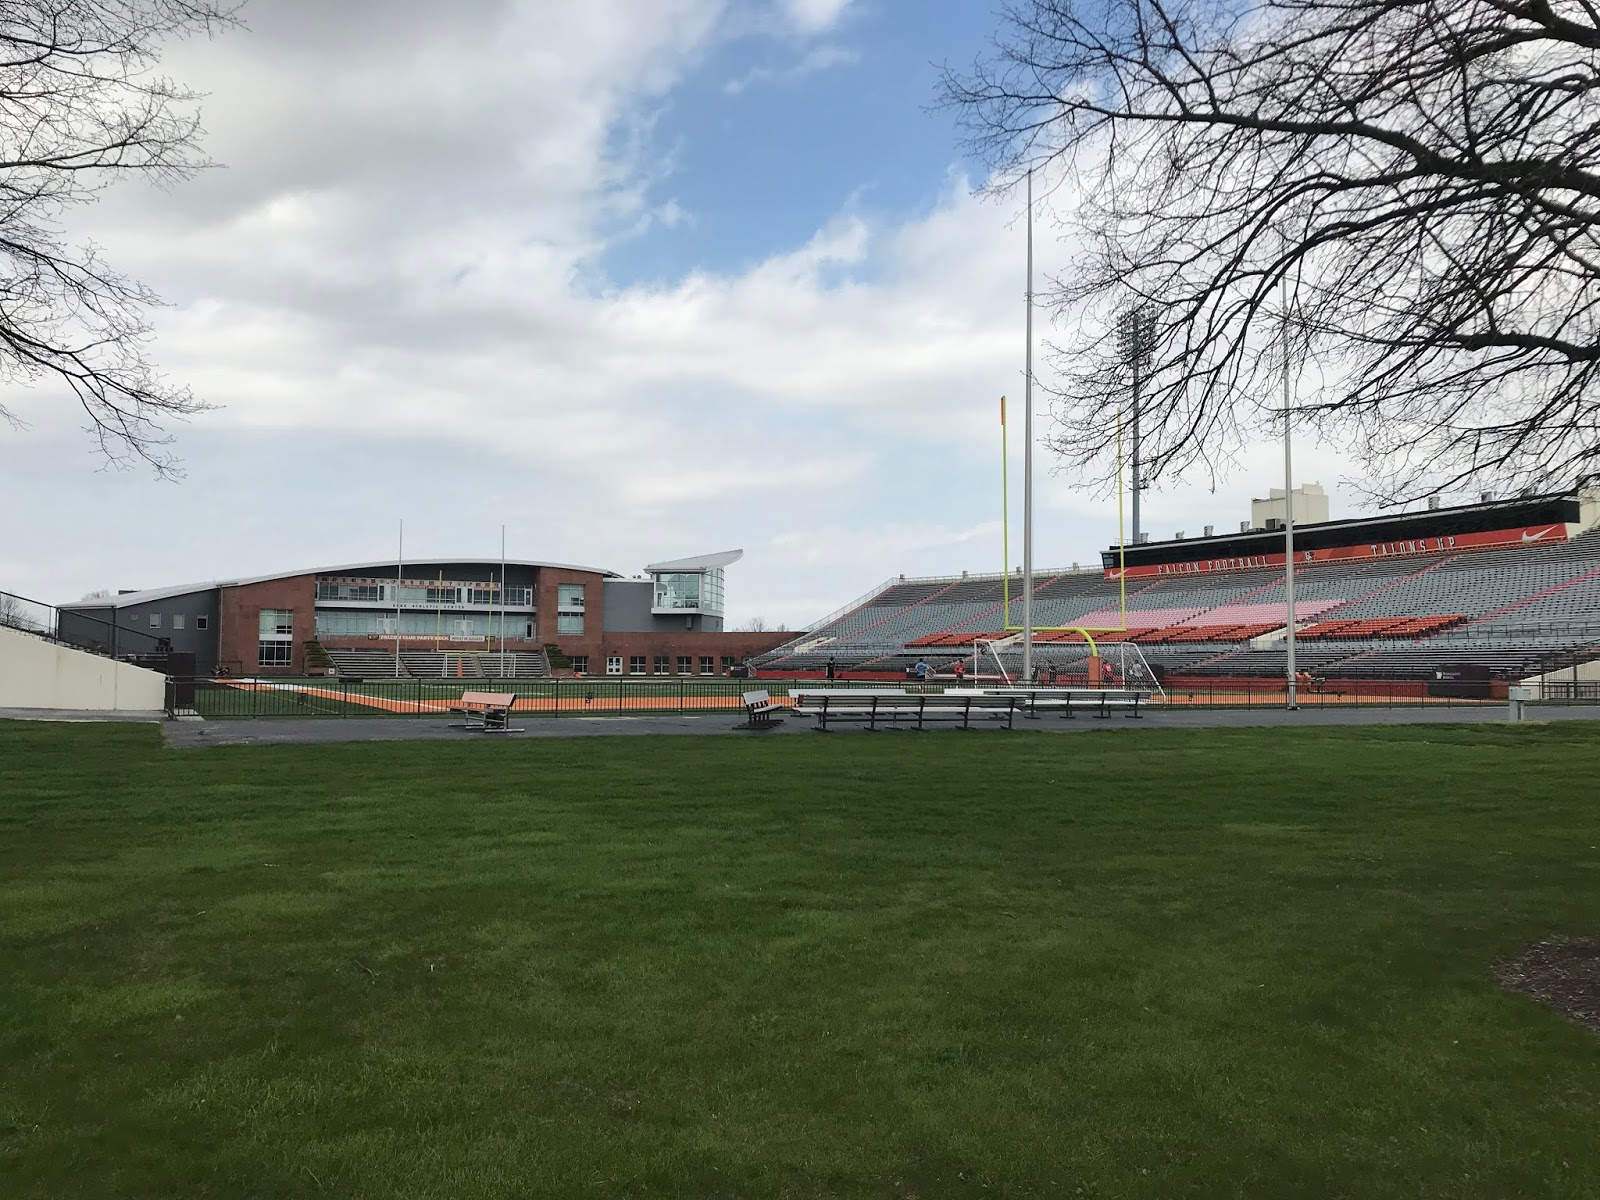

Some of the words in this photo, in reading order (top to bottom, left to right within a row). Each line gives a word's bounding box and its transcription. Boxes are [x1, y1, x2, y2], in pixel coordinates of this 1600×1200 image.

[1370, 540, 1427, 556] TALONS
[1437, 536, 1455, 551] UP
[1157, 561, 1200, 575] FALCON
[1207, 555, 1268, 571] FOOTBALL
